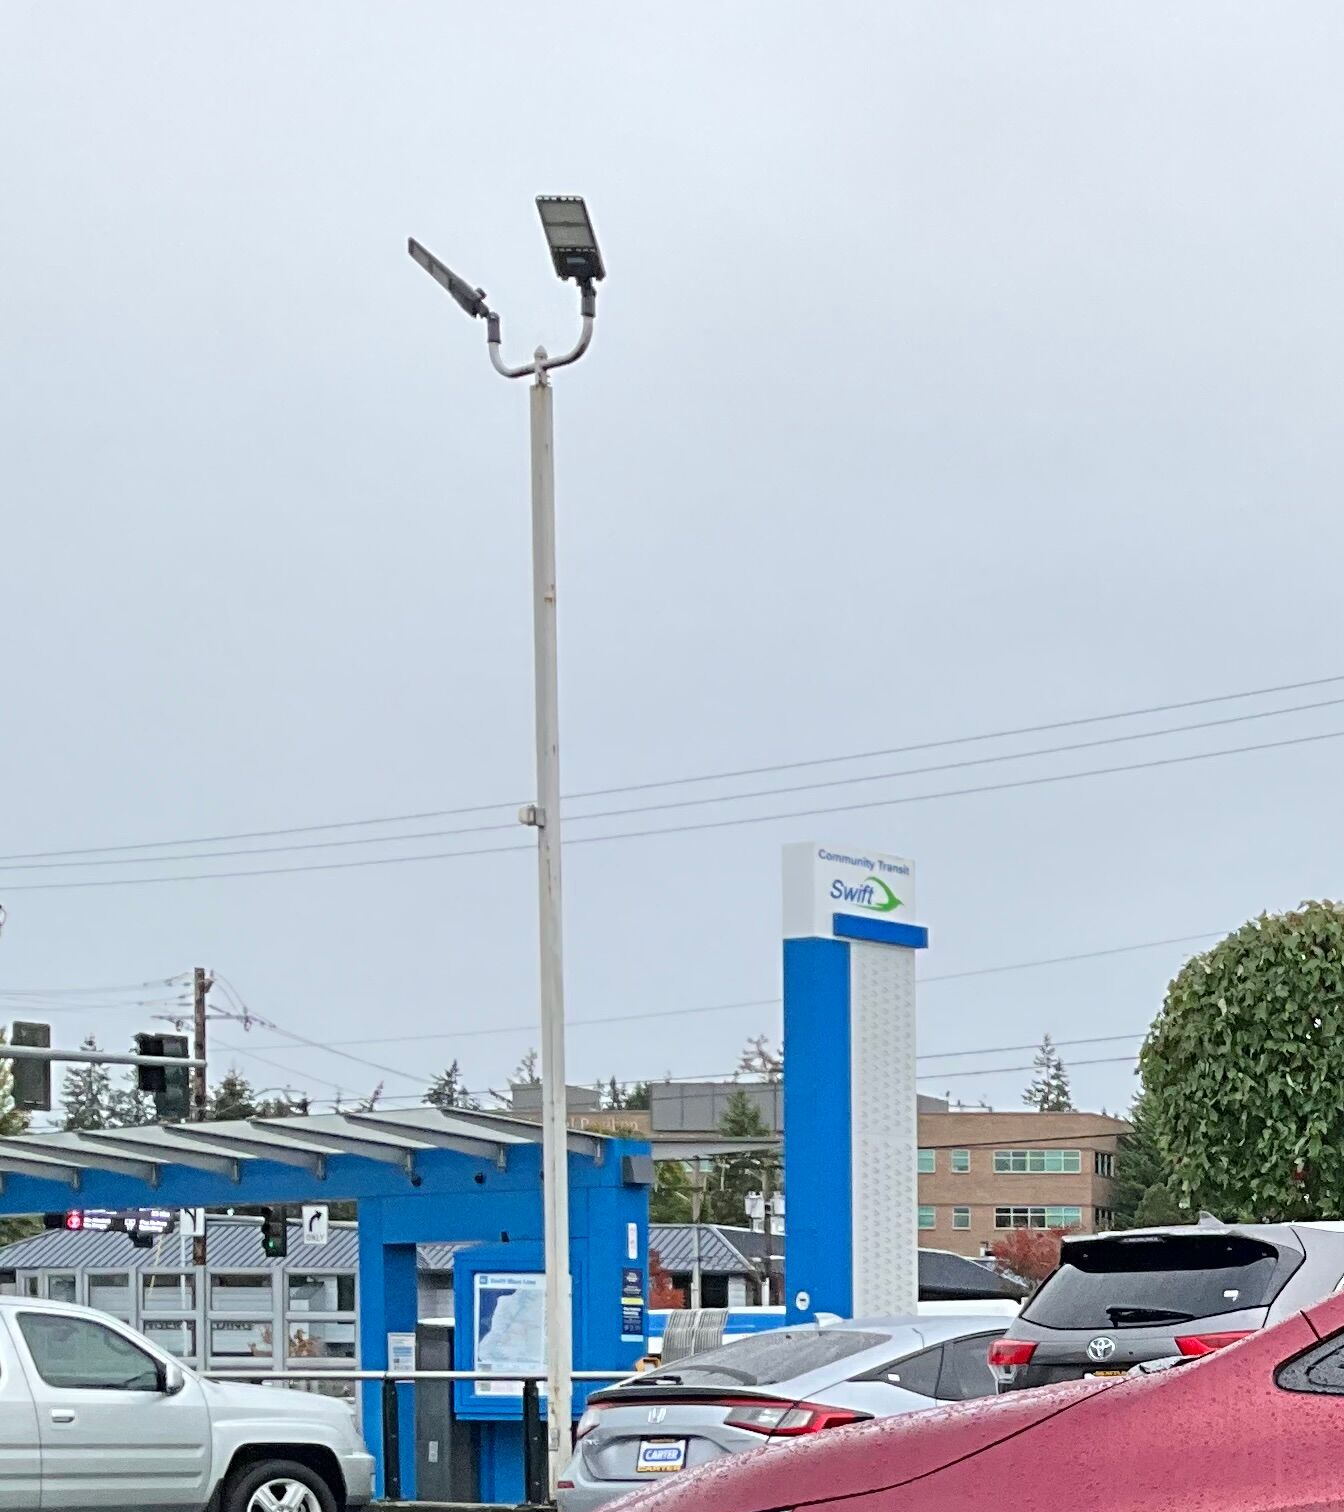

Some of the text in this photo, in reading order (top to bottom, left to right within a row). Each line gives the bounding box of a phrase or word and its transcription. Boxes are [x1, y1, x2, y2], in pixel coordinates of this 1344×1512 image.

[818, 849, 910, 876] Community Transit
[830, 879, 874, 905] Swift
[645, 1449, 679, 1460] CARTER
